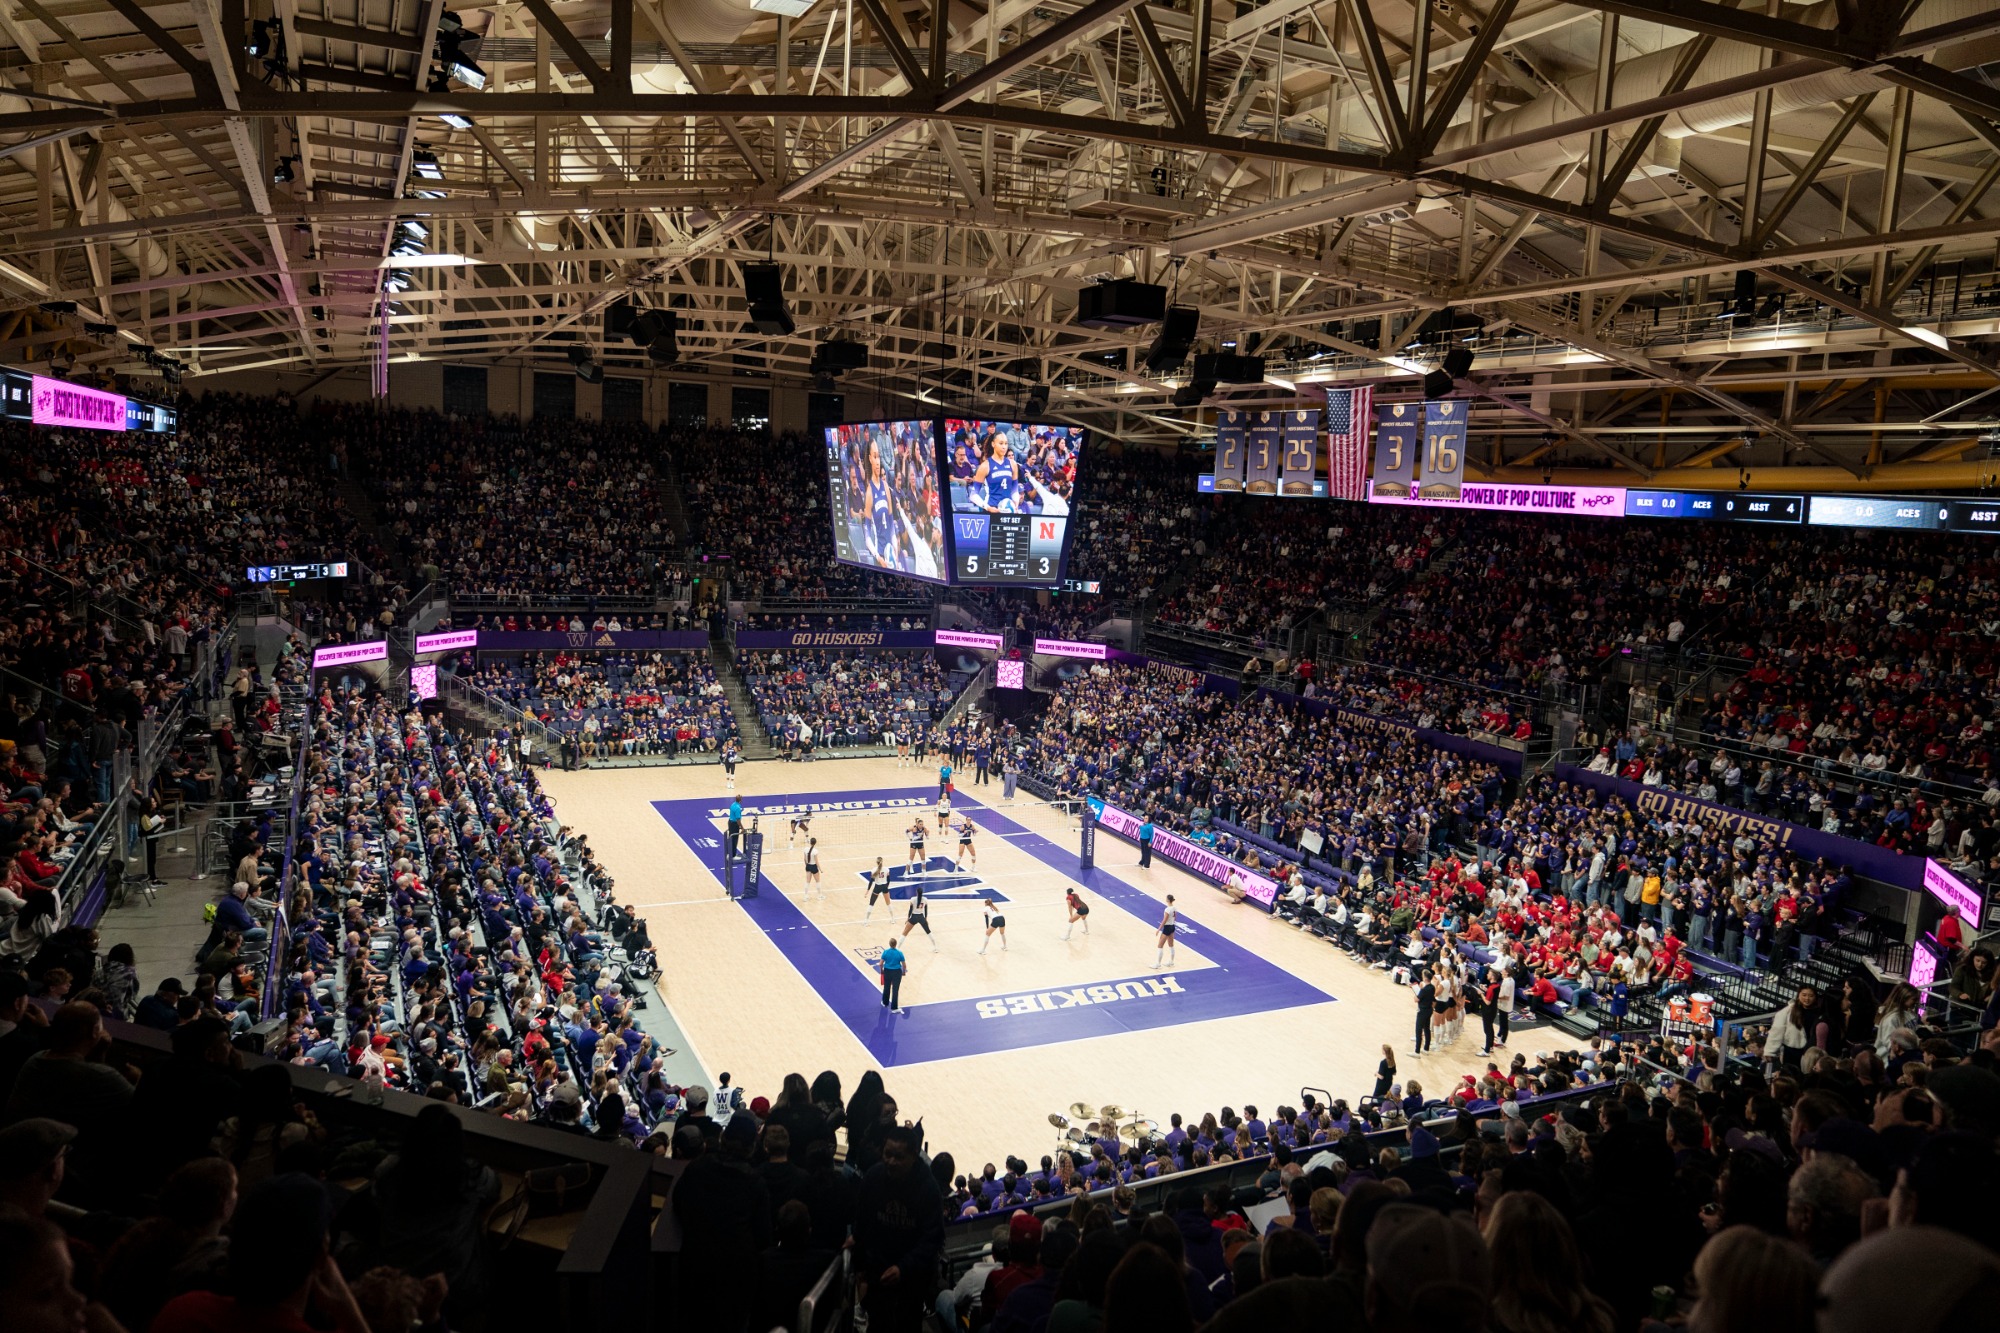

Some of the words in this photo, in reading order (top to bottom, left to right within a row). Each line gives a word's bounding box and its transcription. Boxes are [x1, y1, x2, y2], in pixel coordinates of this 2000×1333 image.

[54, 389, 73, 418] DISCOVER
[1223, 438, 1236, 469] 2
[1256, 439, 1269, 470] 3
[1286, 439, 1313, 471] 25
[1385, 435, 1403, 471] 3
[1428, 434, 1458, 474] 16
[1000, 478, 1008, 490] 4
[1375, 488, 1408, 497] THOMPSON
[1462, 488, 1496, 504] POWER
[1497, 489, 1509, 505] OF
[1510, 490, 1530, 507] POP
[1531, 490, 1576, 509] CULTURE
[1583, 495, 1615, 507] MoPOP
[1661, 498, 1676, 509] 0.0
[1692, 501, 1711, 509] ACES
[1727, 501, 1734, 511] 0
[1749, 503, 1770, 512] ASST
[1786, 504, 1795, 513] 4
[1856, 507, 1873, 517] 0.0
[1896, 509, 1921, 518] ACES
[1939, 509, 1948, 520] 0
[1971, 511, 1999, 522] ASST
[959, 518, 985, 539] W
[1039, 522, 1055, 540] N
[322, 566, 329, 576] 3
[336, 565, 346, 575] N
[967, 555, 978, 573] 5
[1038, 556, 1050, 575] 3
[270, 569, 277, 579] 5
[1076, 582, 1082, 591] 3
[566, 632, 588, 647] W
[791, 633, 812, 645] GO
[317, 653, 335, 661] DISCOVER
[1336, 710, 1375, 733] DAWG
[1379, 720, 1417, 744] PACK
[708, 797, 928, 817] WASHINGTON
[1636, 789, 1668, 813] GO
[749, 851, 759, 883] HUSKIES
[1152, 833, 1167, 852] THE
[1165, 838, 1191, 863] POWER
[1189, 850, 1201, 867] OF
[1197, 855, 1215, 875] POP
[1248, 884, 1274, 898] MoPOP
[1926, 867, 1940, 886] DISCOVER
[1944, 881, 1955, 898] POWER
[1957, 892, 1965, 905] POP
[1963, 897, 1978, 916] CULTURE
[974, 976, 1186, 1019] HUSKIES
[1700, 1005, 1709, 1014] G
[716, 1093, 728, 1103] W
